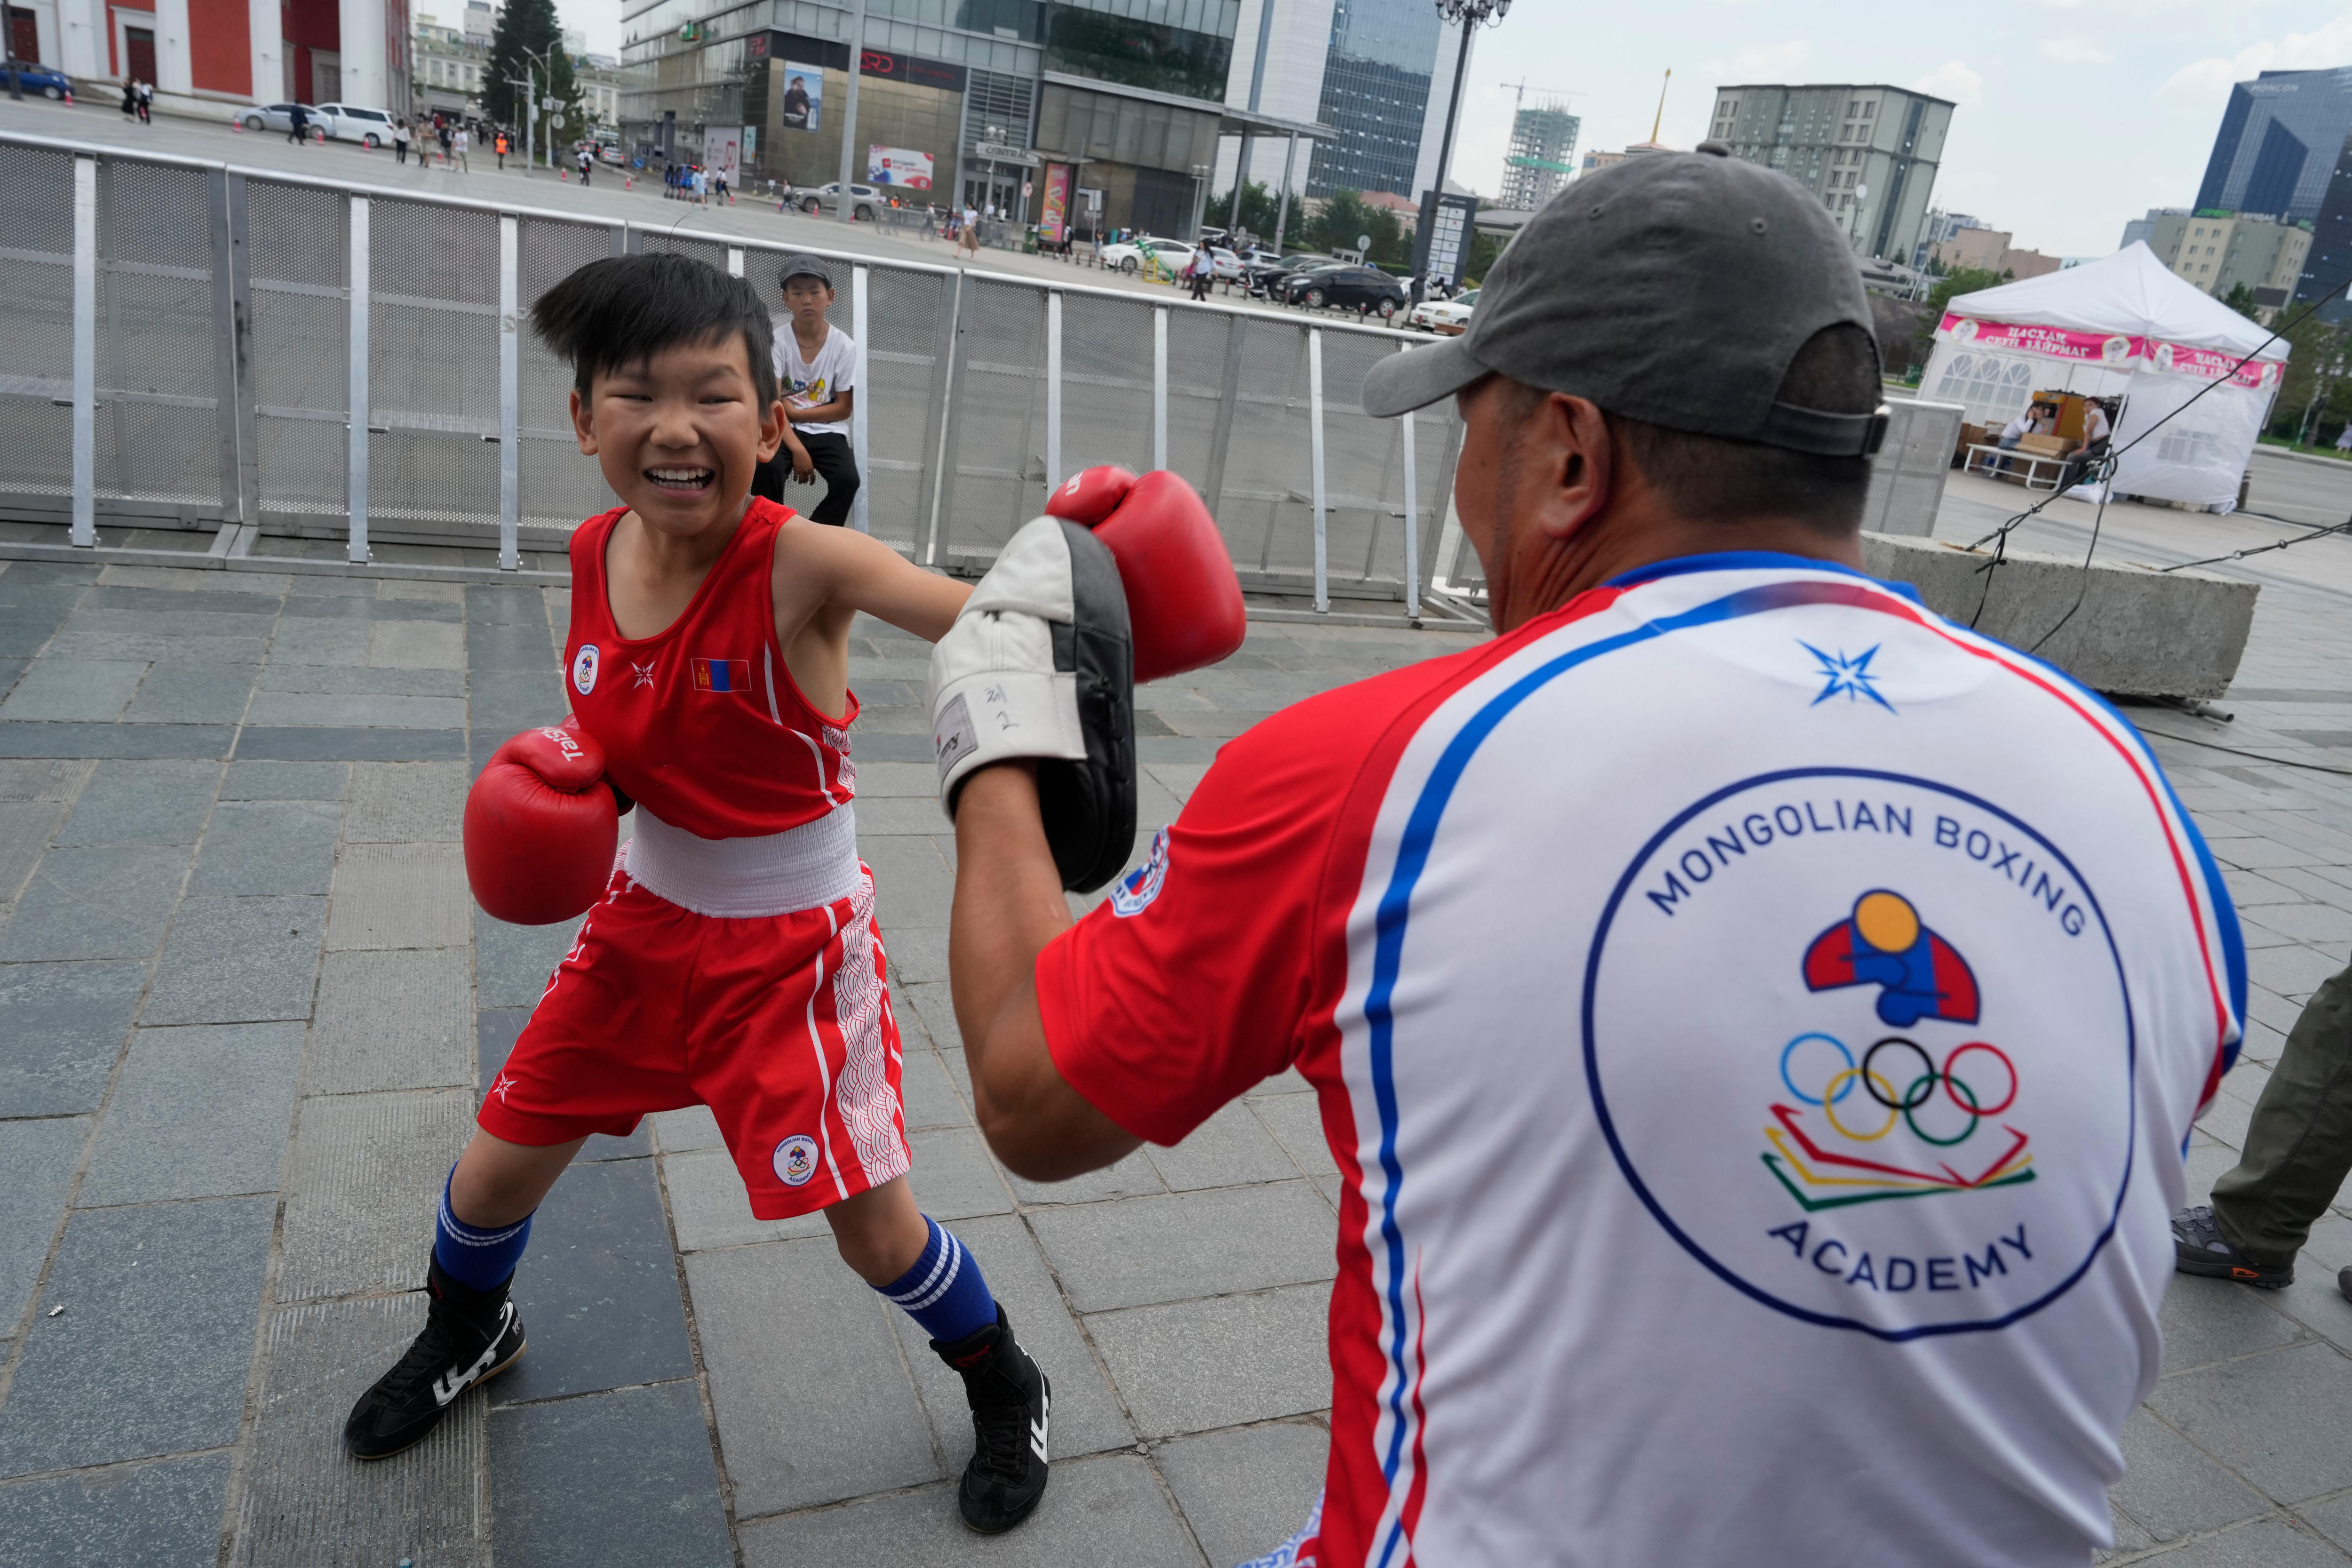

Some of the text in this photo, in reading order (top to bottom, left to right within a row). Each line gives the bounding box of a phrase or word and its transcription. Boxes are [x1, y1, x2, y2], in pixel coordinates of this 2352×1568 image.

[1646, 798, 2087, 937] MONGOLIAN BOXING
[777, 1137, 800, 1154] MONGOLIAN
[788, 1171, 811, 1182] ACADEMY
[1766, 1220, 2034, 1292] ACADEMY
